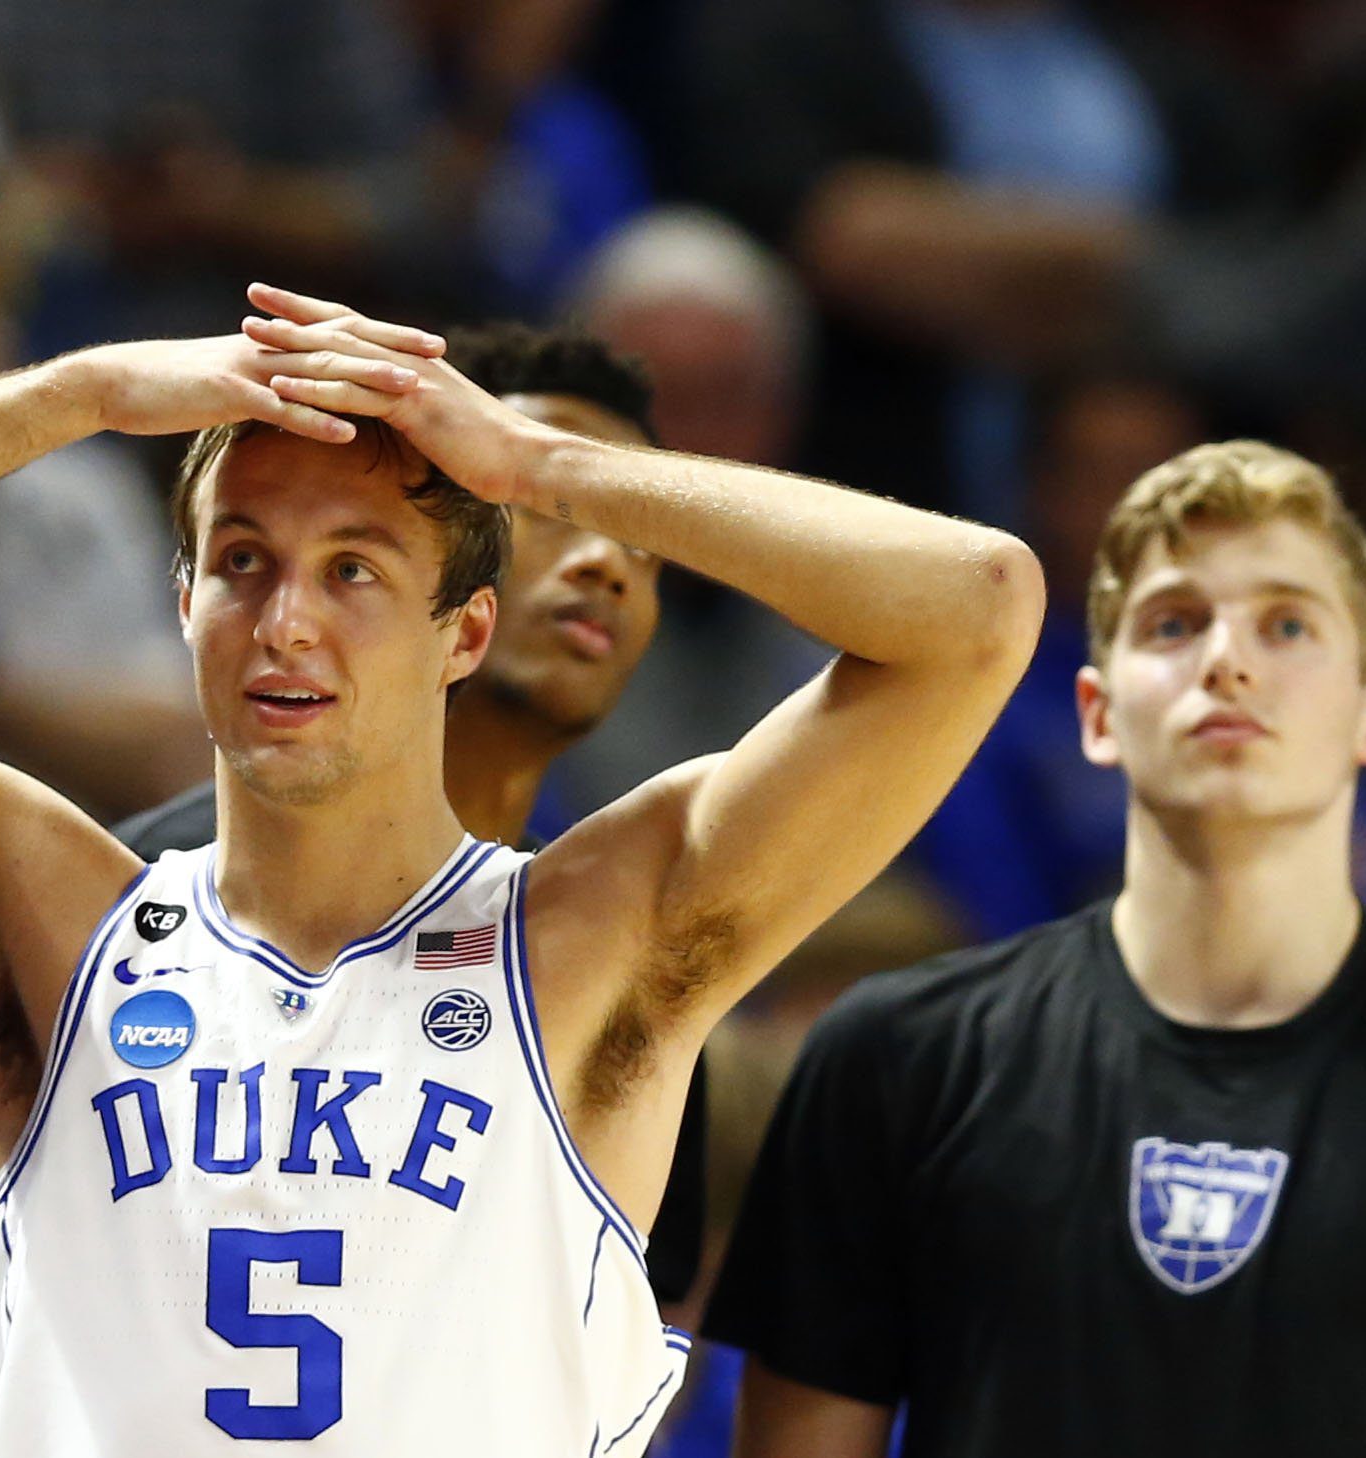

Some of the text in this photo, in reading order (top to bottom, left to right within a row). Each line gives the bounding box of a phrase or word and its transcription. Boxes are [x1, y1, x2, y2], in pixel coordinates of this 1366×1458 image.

[141, 906, 181, 931] KB
[431, 1008, 487, 1024] ACC
[117, 1024, 189, 1048] NCAA
[91, 1061, 494, 1213] DUKE
[205, 1227, 344, 1441] 5
